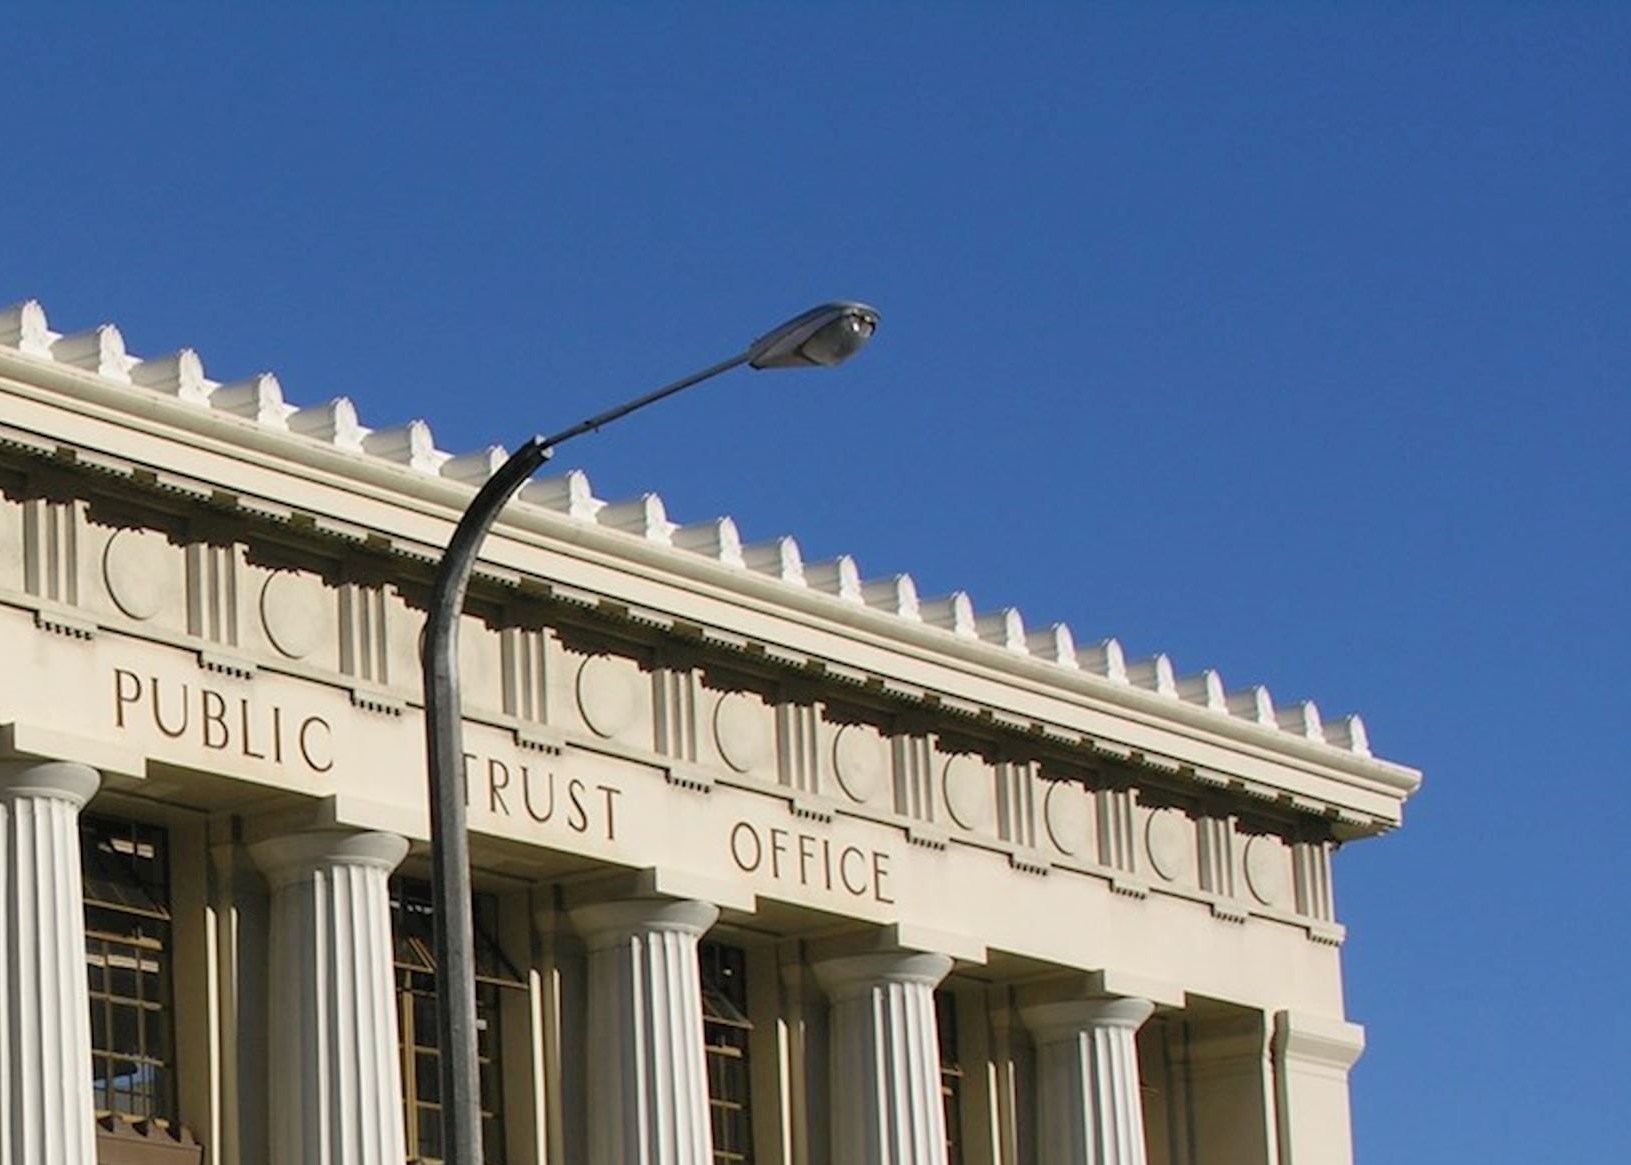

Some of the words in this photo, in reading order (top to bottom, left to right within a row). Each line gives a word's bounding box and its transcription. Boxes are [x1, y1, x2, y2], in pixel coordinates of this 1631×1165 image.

[113, 668, 334, 773] PUBLIC
[463, 752, 622, 841] TRUST
[731, 821, 895, 905] OFFICE
